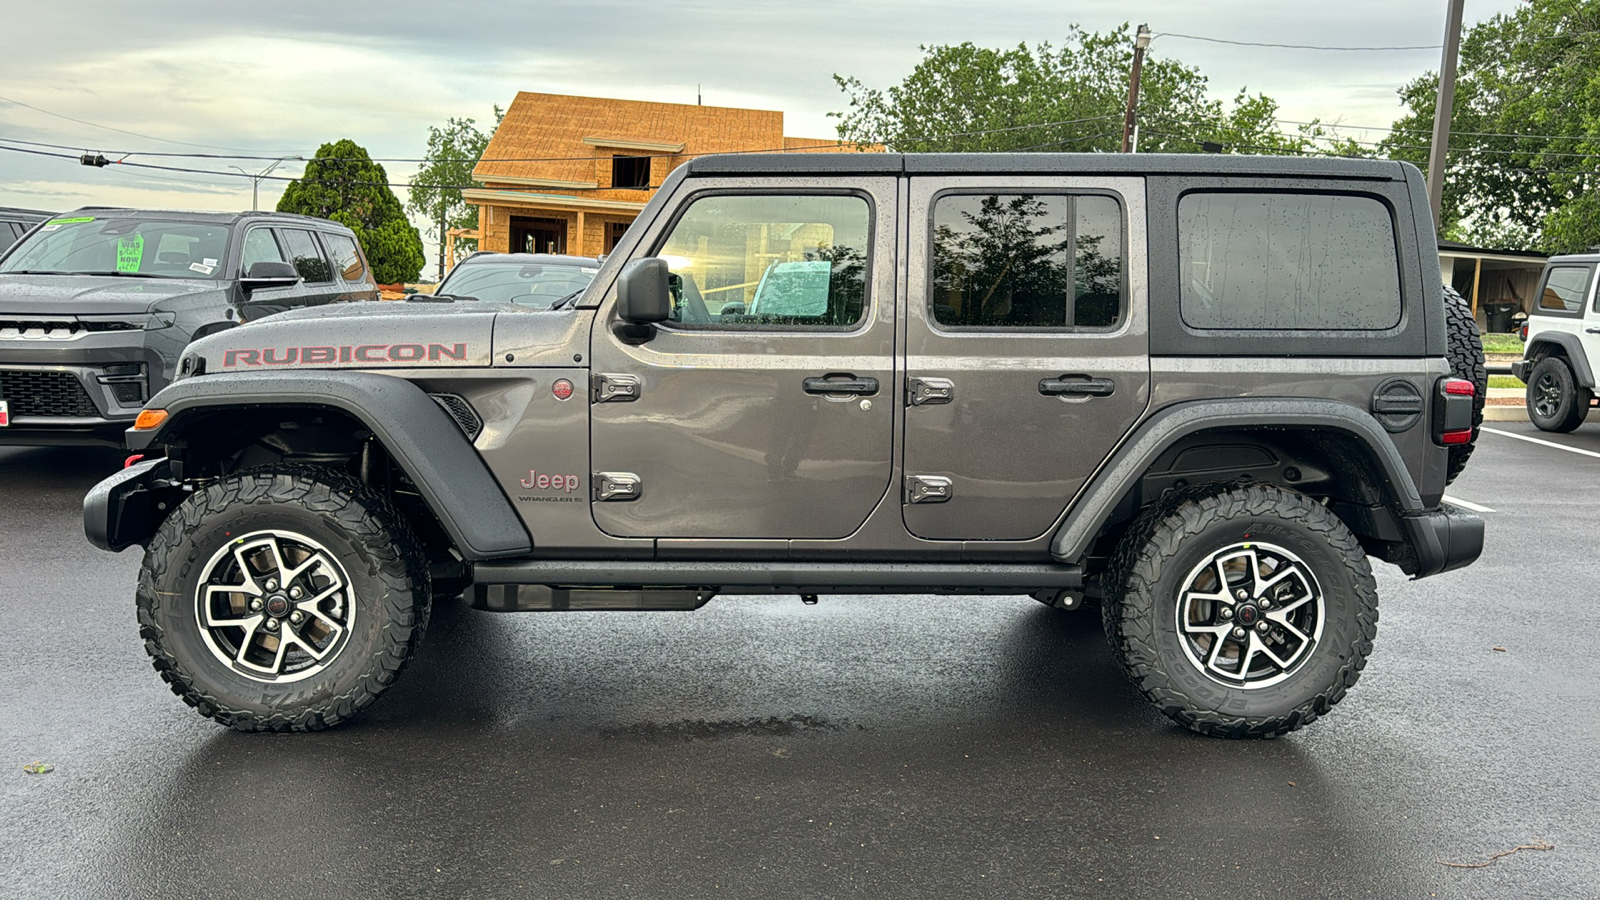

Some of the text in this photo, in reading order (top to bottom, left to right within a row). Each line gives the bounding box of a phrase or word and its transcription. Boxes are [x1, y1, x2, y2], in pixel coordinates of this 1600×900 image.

[121, 241, 141, 249] WAS
[222, 343, 468, 367] RUBICON
[520, 469, 580, 494] Jeep
